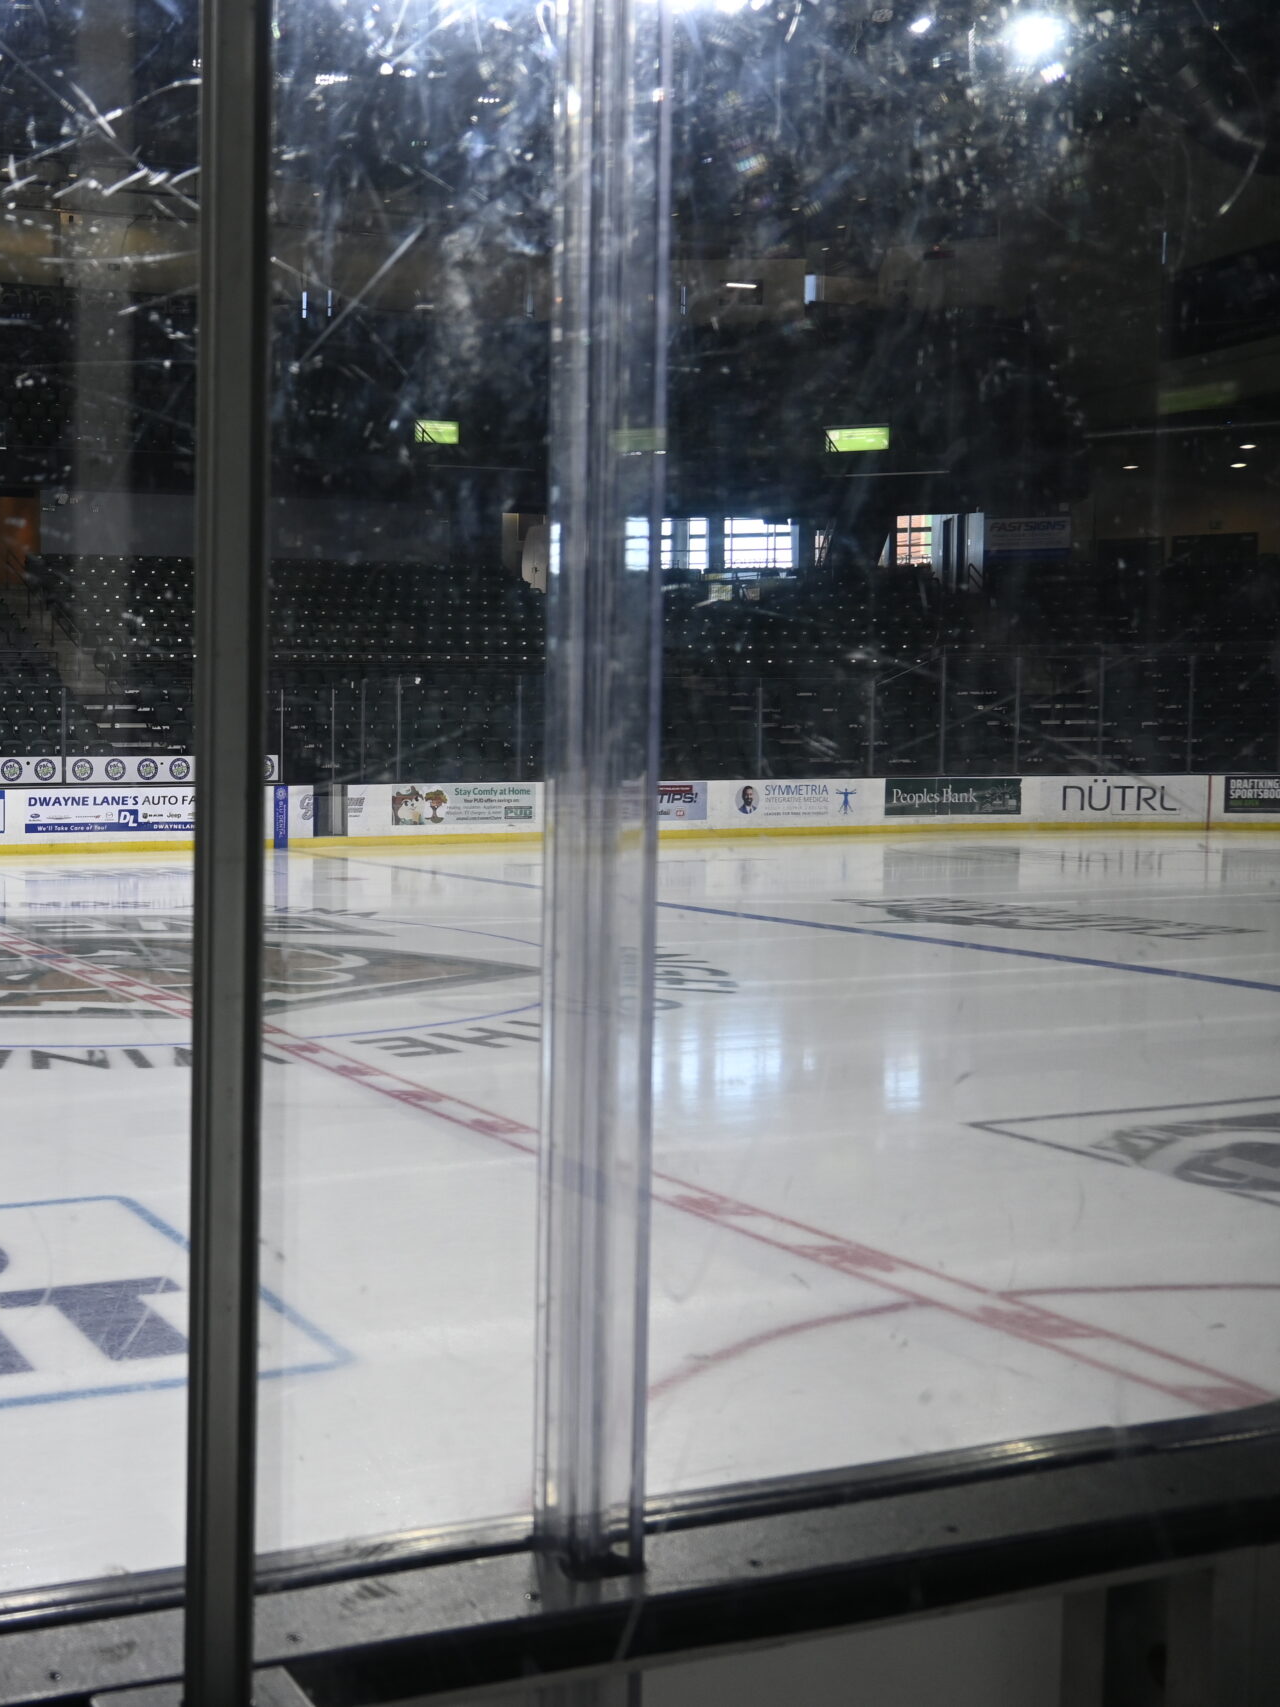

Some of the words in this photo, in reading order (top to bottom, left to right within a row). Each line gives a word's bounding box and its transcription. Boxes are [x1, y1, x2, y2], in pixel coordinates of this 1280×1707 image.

[990, 520, 1065, 532] FASTSIGNS
[454, 787, 471, 797] Stay
[472, 787, 498, 796] Comfy
[499, 787, 507, 795] at
[508, 786, 531, 795] Home
[765, 784, 828, 795] SYMMETRIA
[28, 797, 89, 806] DWAYNE
[93, 796, 138, 805] LANE'S
[141, 795, 178, 806] AUTO
[893, 788, 939, 807] Peoples
[943, 788, 977, 803] Bank
[119, 811, 138, 827] DL
